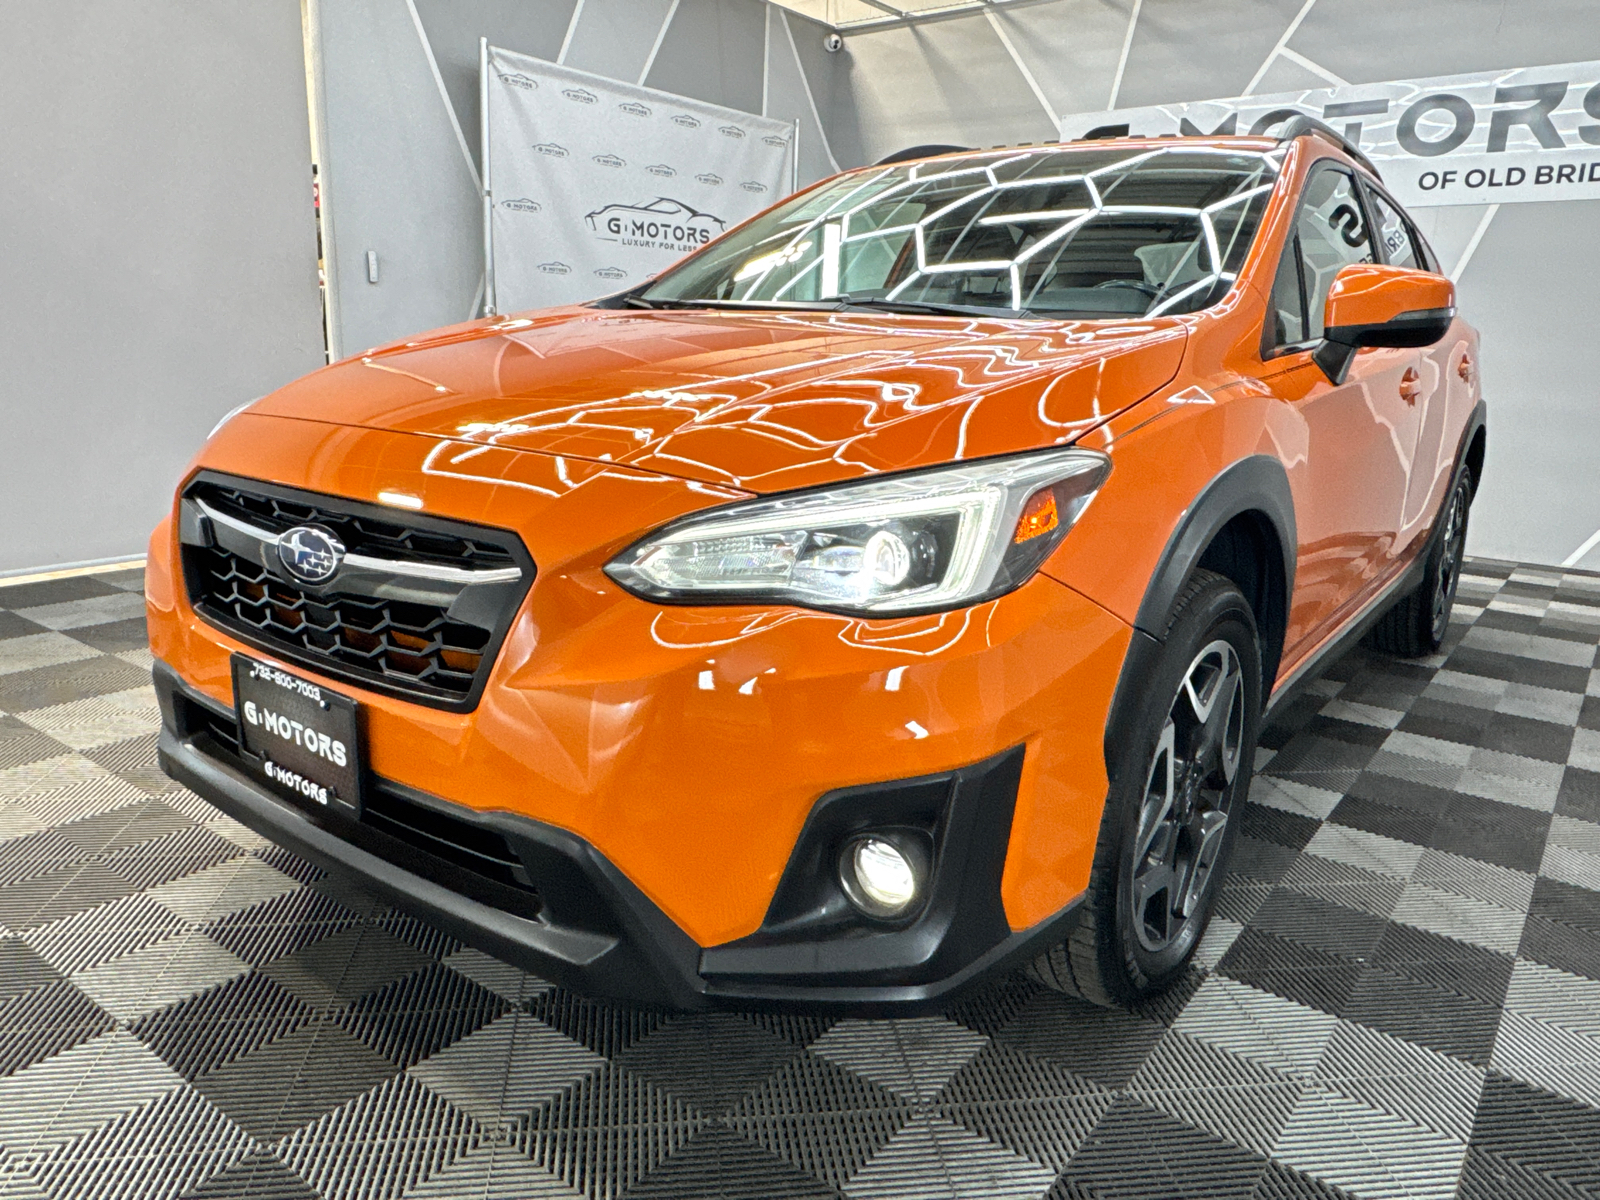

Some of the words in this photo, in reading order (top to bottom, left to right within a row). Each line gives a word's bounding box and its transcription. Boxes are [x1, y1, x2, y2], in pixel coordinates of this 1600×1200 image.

[1418, 170, 1458, 191] OF
[1464, 167, 1526, 189] OLD
[621, 238, 656, 249] LUXURY
[659, 242, 675, 251] FOR
